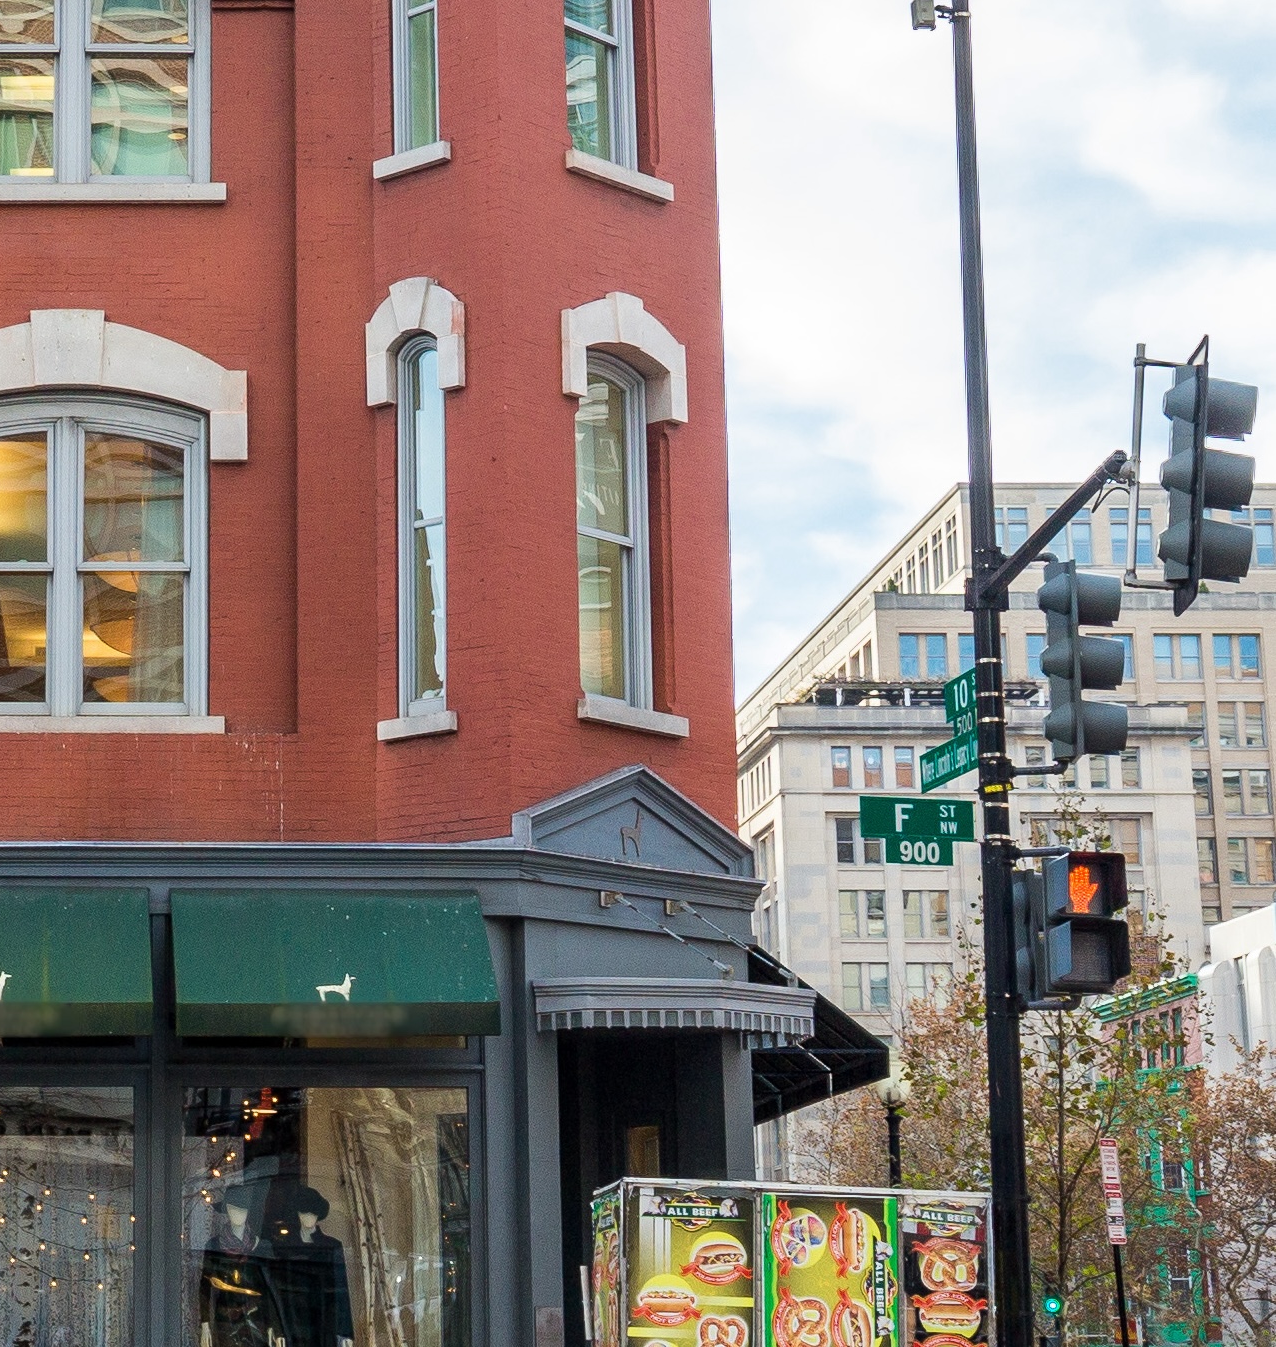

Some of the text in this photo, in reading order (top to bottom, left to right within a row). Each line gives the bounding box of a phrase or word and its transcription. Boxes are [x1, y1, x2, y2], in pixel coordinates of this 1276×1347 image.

[954, 679, 968, 711] 10
[957, 711, 973, 736] 500
[922, 758, 935, 785] Where
[935, 746, 954, 778] Lincoln's
[954, 739, 970, 774] Legacy
[895, 804, 913, 832] F
[940, 805, 955, 817] ST
[940, 822, 957, 834] NW
[899, 840, 940, 863] 900
[667, 1207, 719, 1217] ALL BEEF
[921, 1210, 973, 1224] ALL BEEF
[874, 1261, 885, 1315] ALL BEEF
